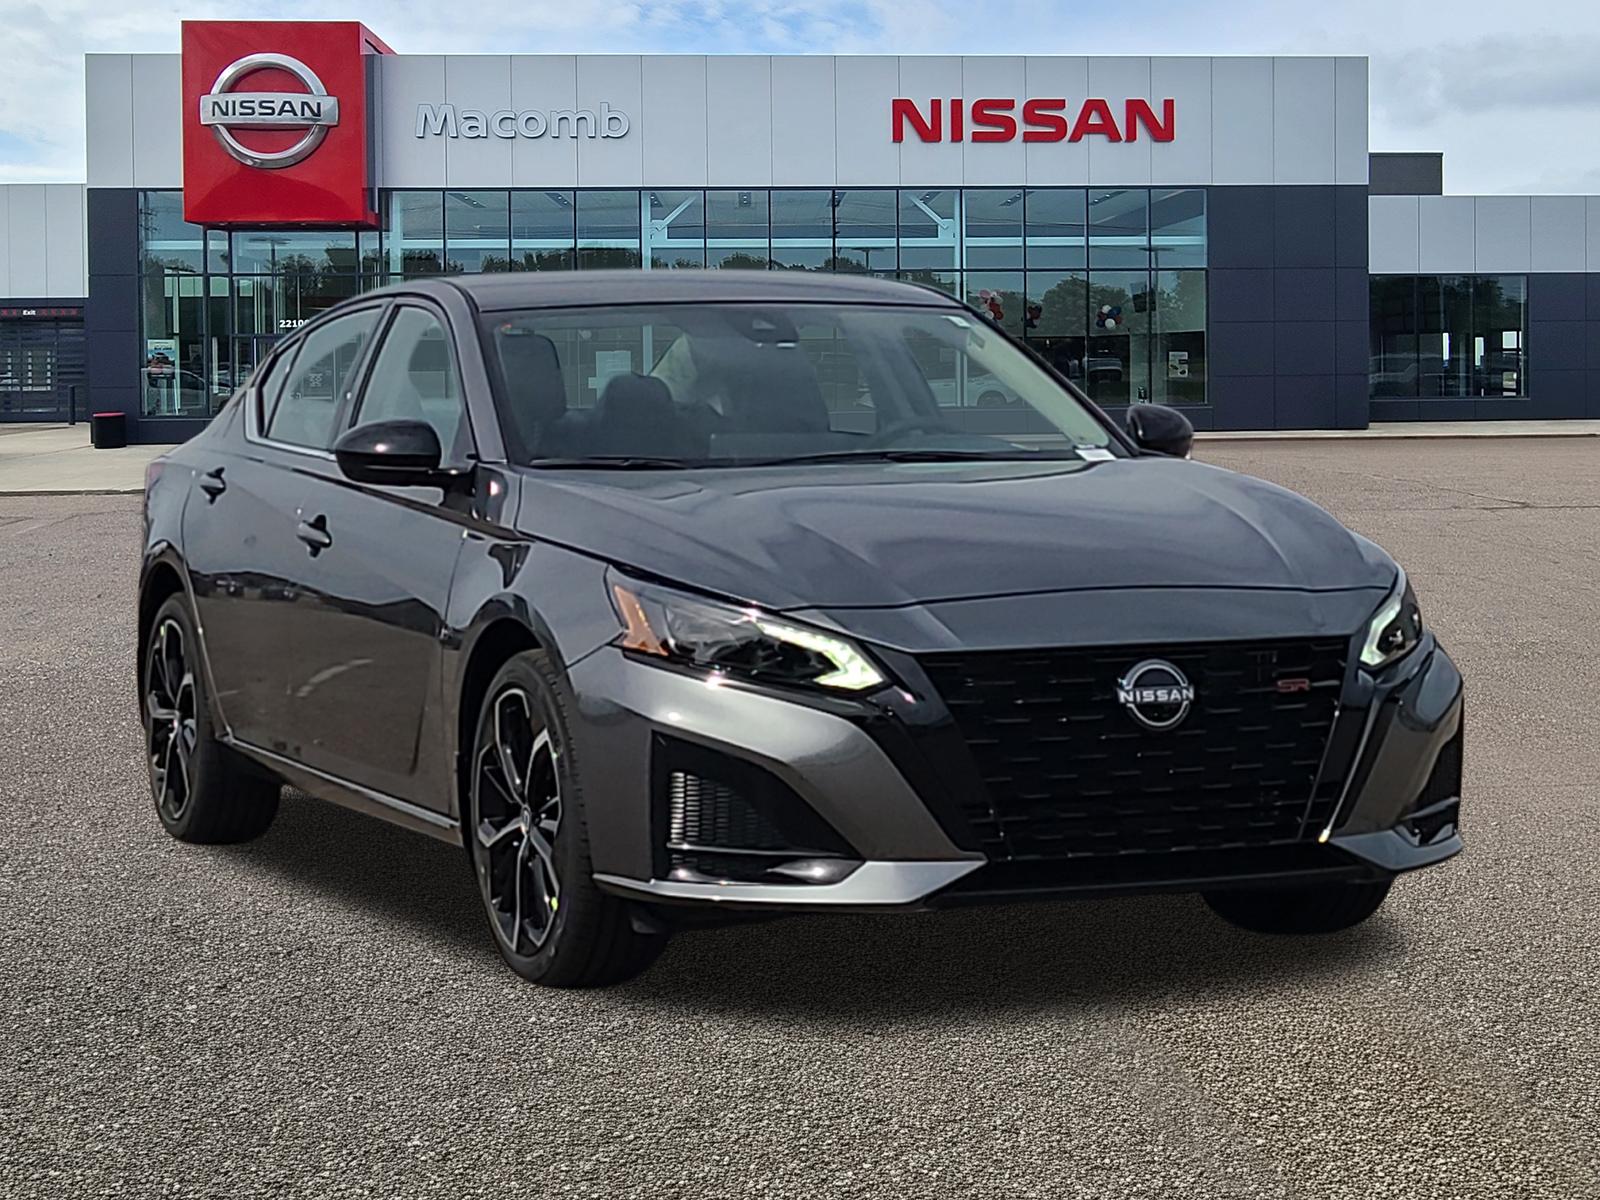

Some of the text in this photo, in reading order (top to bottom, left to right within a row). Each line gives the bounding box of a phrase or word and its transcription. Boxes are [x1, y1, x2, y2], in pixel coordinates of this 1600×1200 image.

[211, 100, 322, 118] NISSAN
[415, 101, 631, 139] Macomb
[891, 98, 1176, 143] NISSAN
[1118, 685, 1195, 704] NISSAN
[1277, 678, 1310, 692] SR
